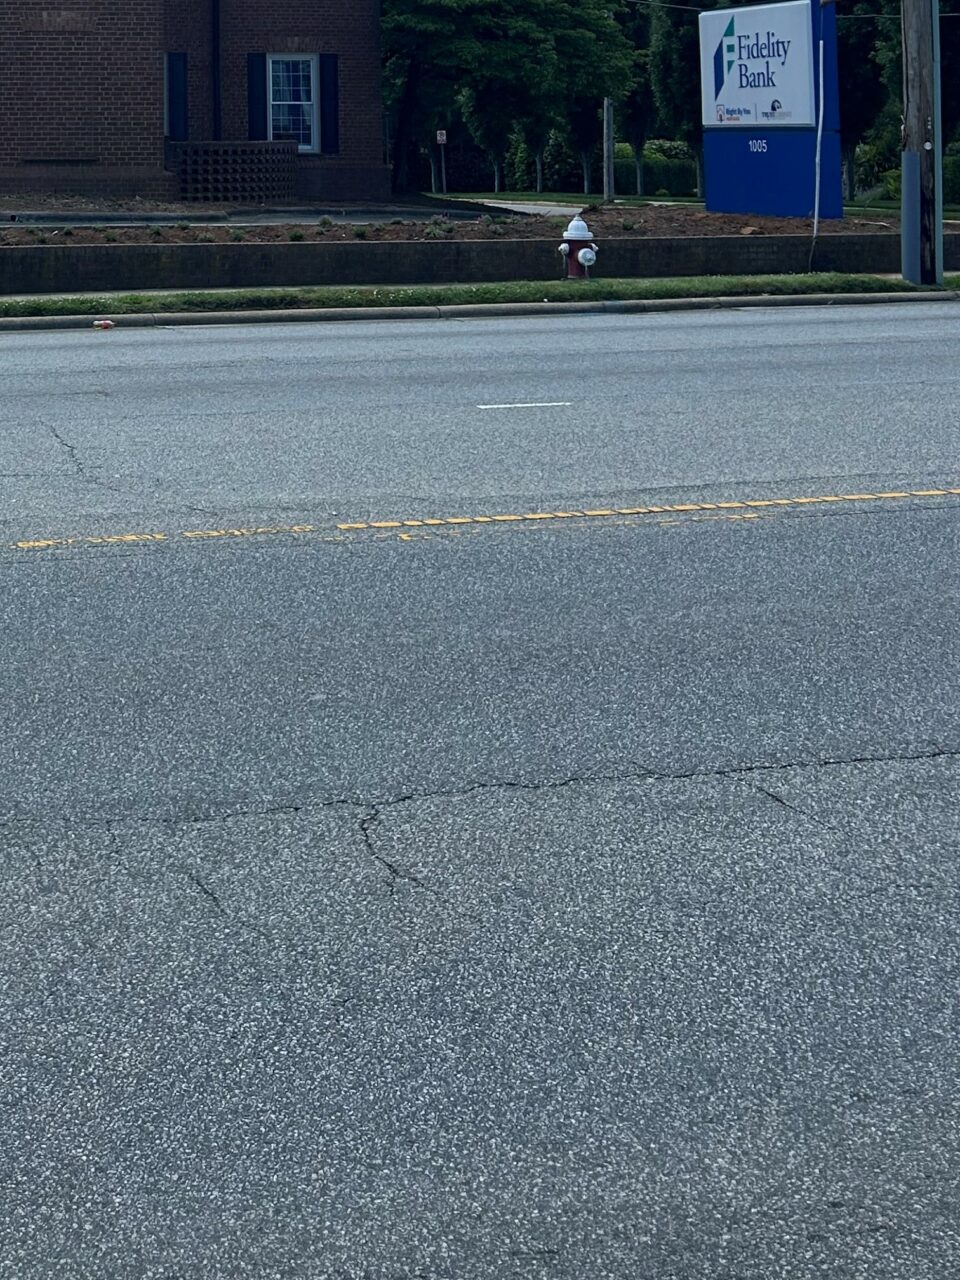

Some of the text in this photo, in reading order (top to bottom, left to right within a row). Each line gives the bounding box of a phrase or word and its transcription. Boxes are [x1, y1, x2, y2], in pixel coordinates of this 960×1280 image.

[737, 31, 791, 66] Fidelity
[738, 60, 776, 89] Bank
[748, 139, 768, 152] 1005
